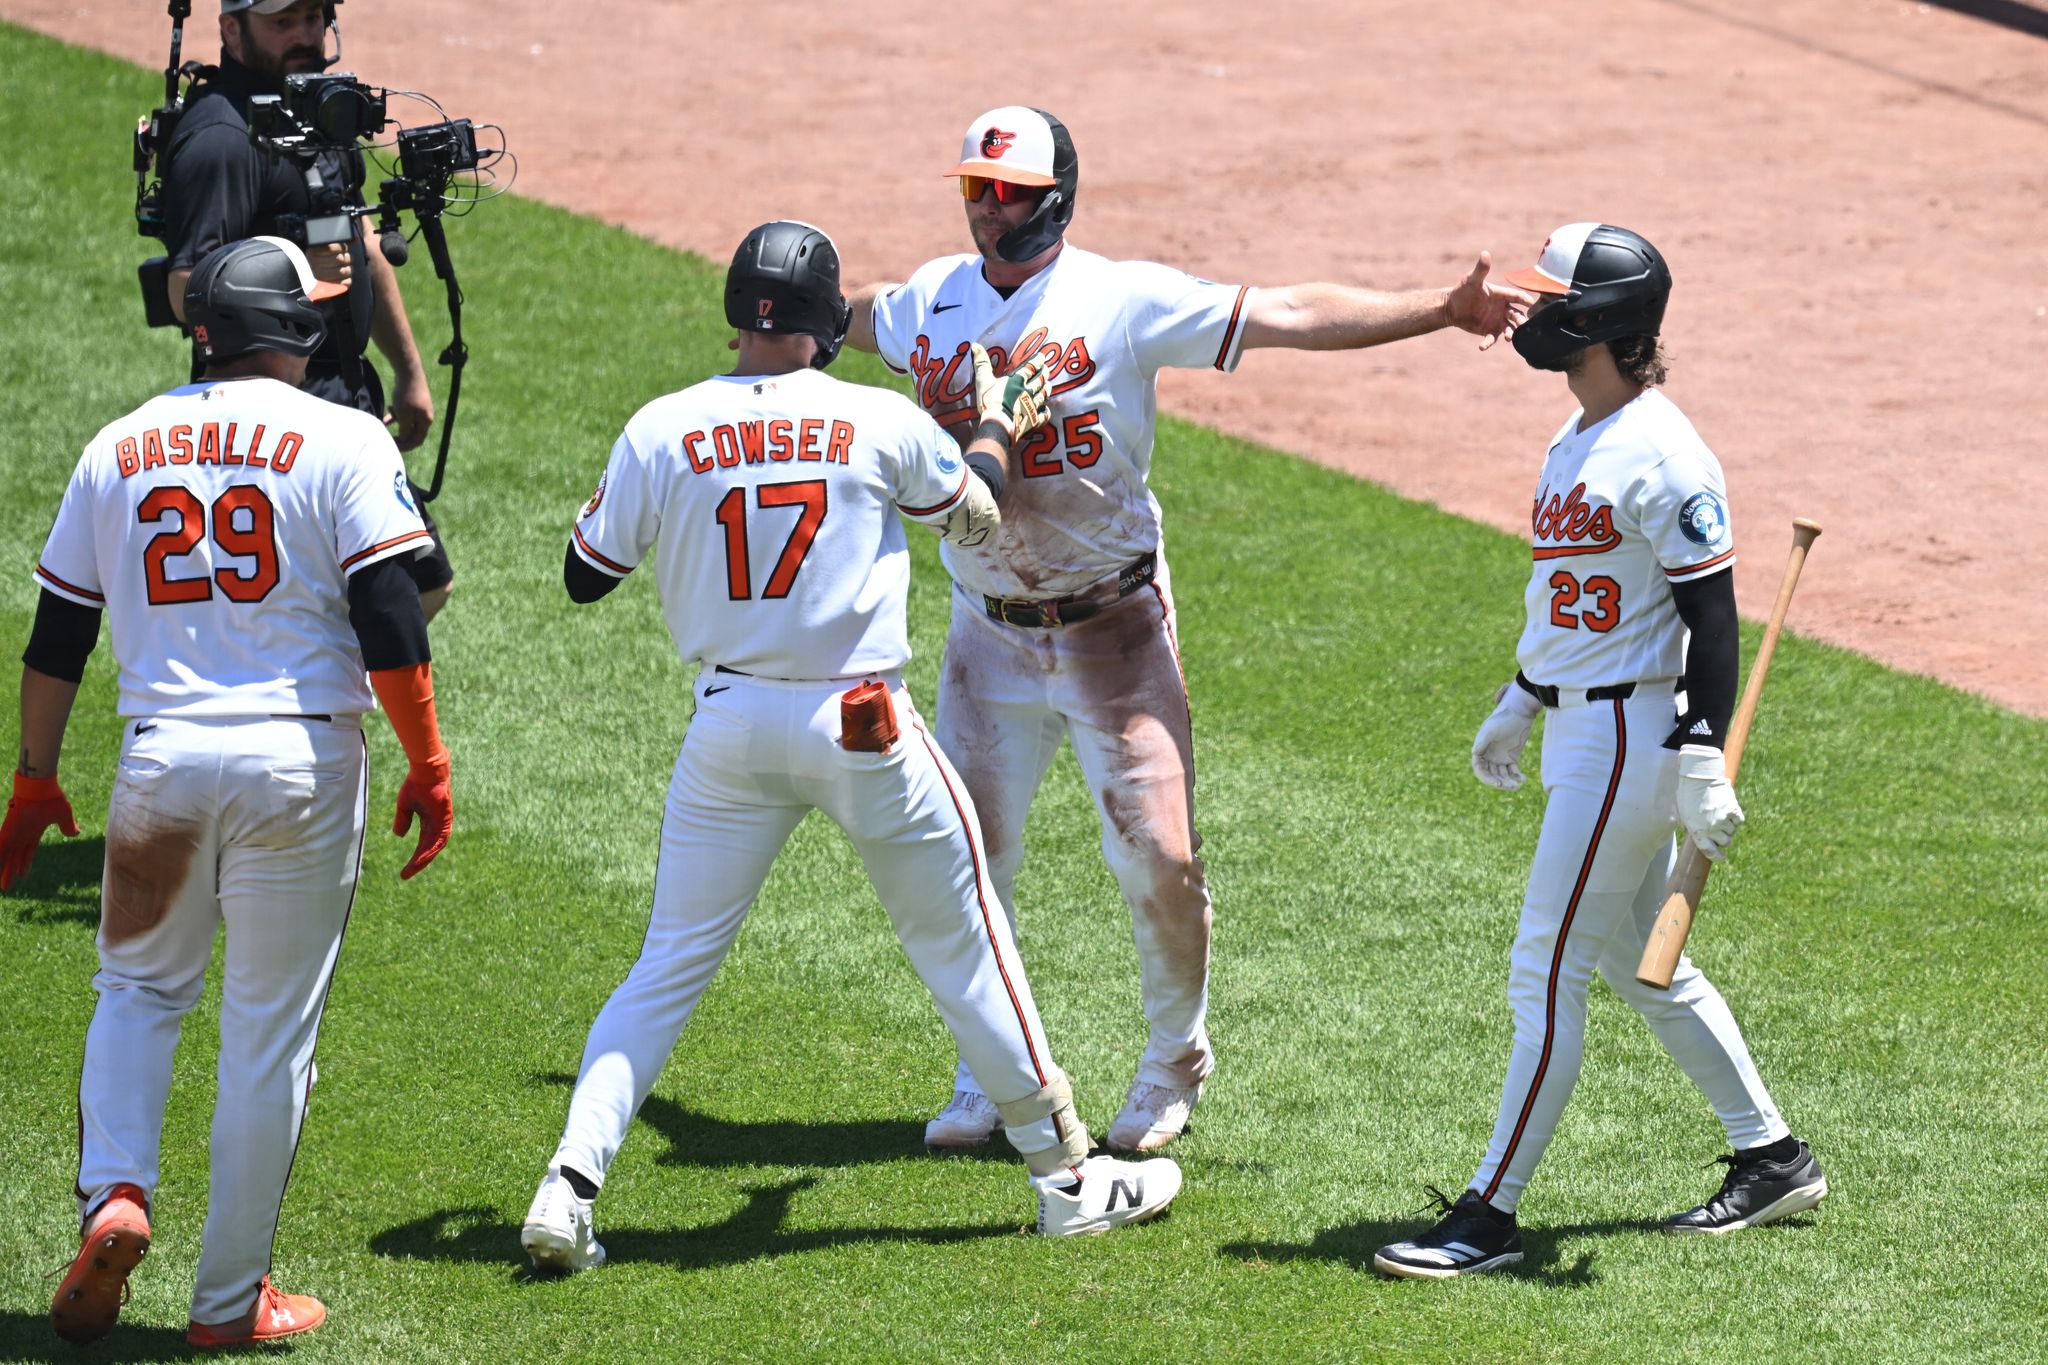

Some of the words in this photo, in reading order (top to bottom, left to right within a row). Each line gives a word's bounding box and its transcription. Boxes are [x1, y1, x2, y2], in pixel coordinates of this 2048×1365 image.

[759, 299, 773, 316] 17
[115, 422, 304, 479] BASALLO
[682, 418, 855, 475] COWSER
[1021, 409, 1104, 479] 25
[137, 484, 281, 606] 29
[715, 479, 828, 601] 17
[1119, 563, 1152, 590] SHOW
[1549, 570, 1621, 633] 23
